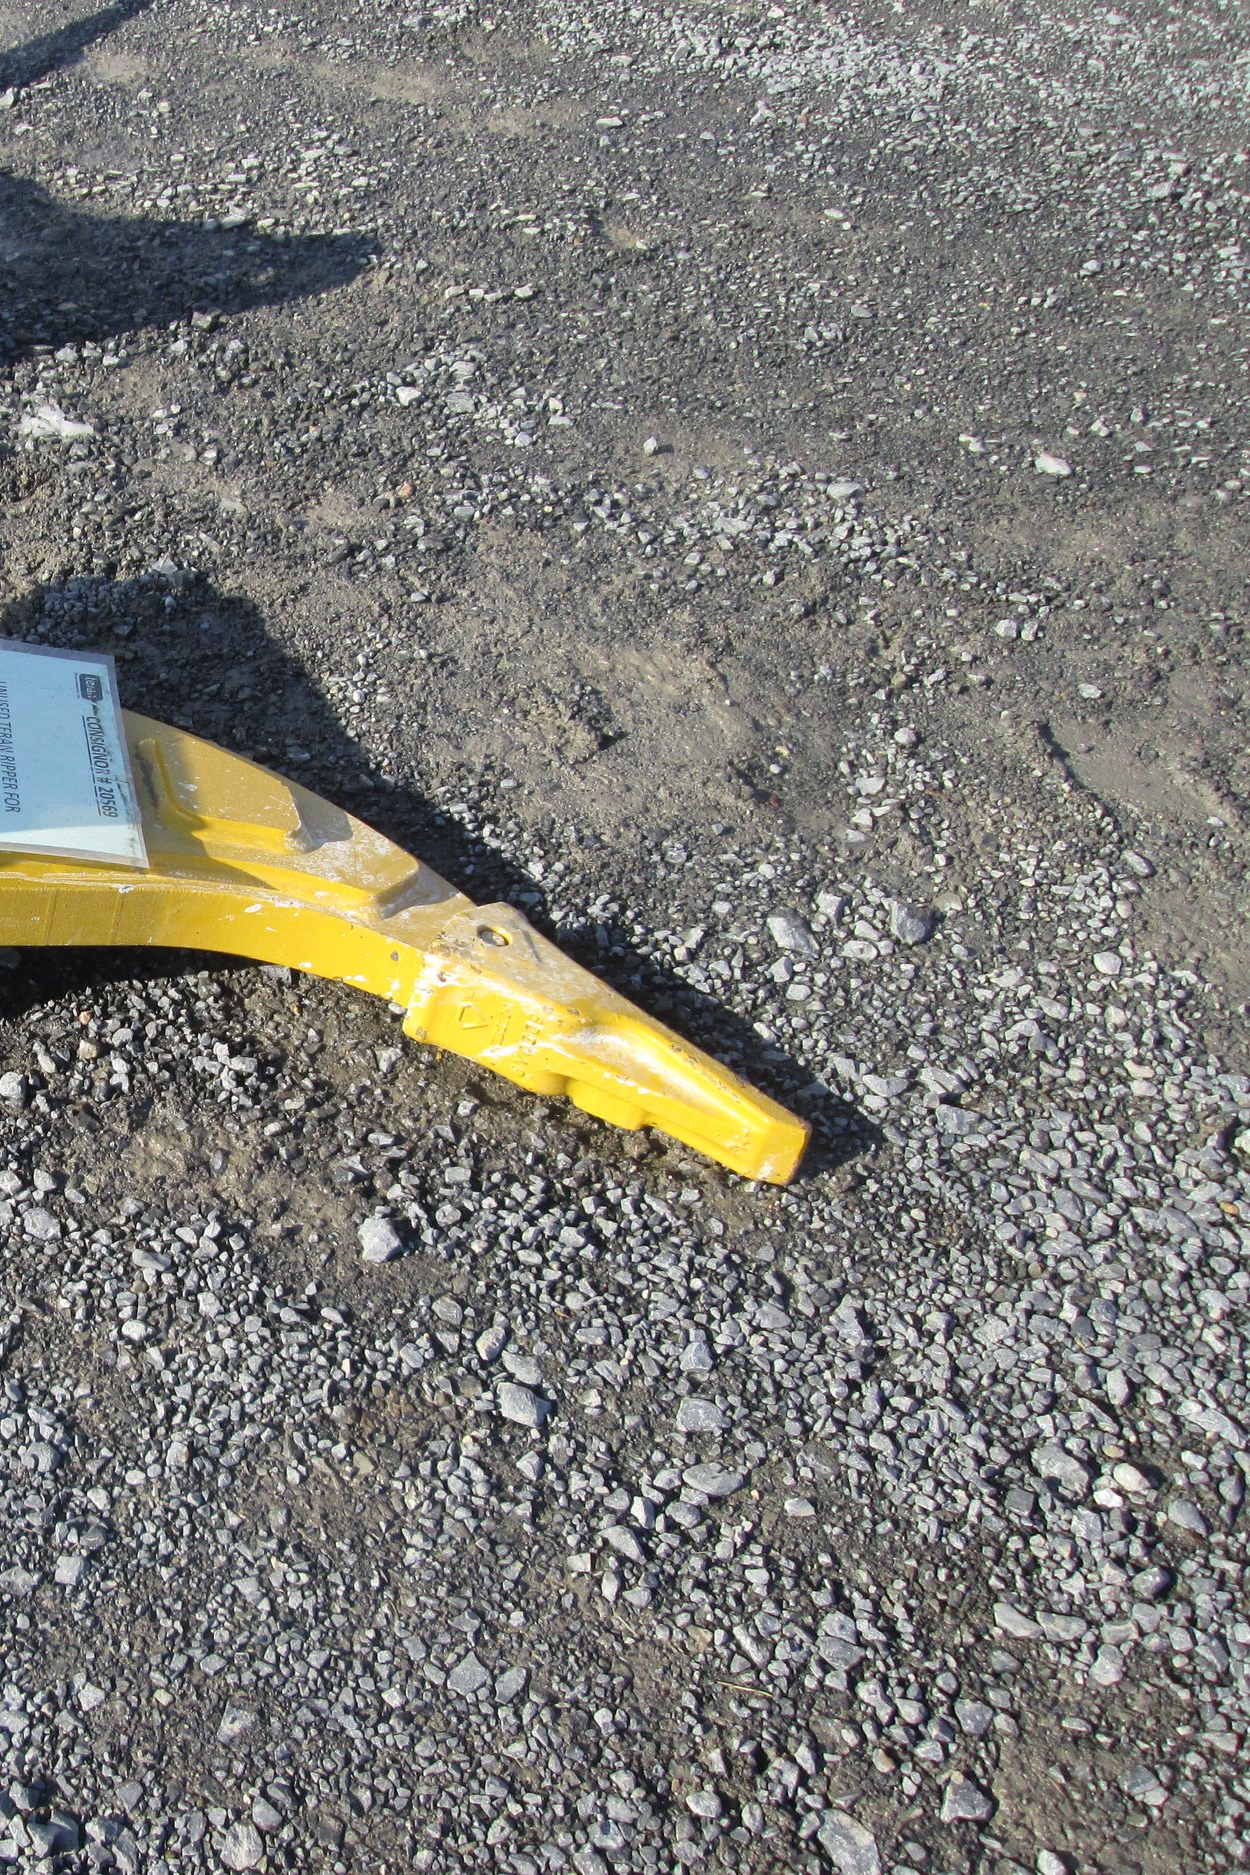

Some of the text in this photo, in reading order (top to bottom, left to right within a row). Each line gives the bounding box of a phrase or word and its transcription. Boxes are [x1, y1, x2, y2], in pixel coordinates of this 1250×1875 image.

[0, 754, 18, 790] RIPPER
[86, 716, 110, 774] CONSIGNOR
[98, 787, 119, 818] 20569
[3, 792, 21, 813] FOR
